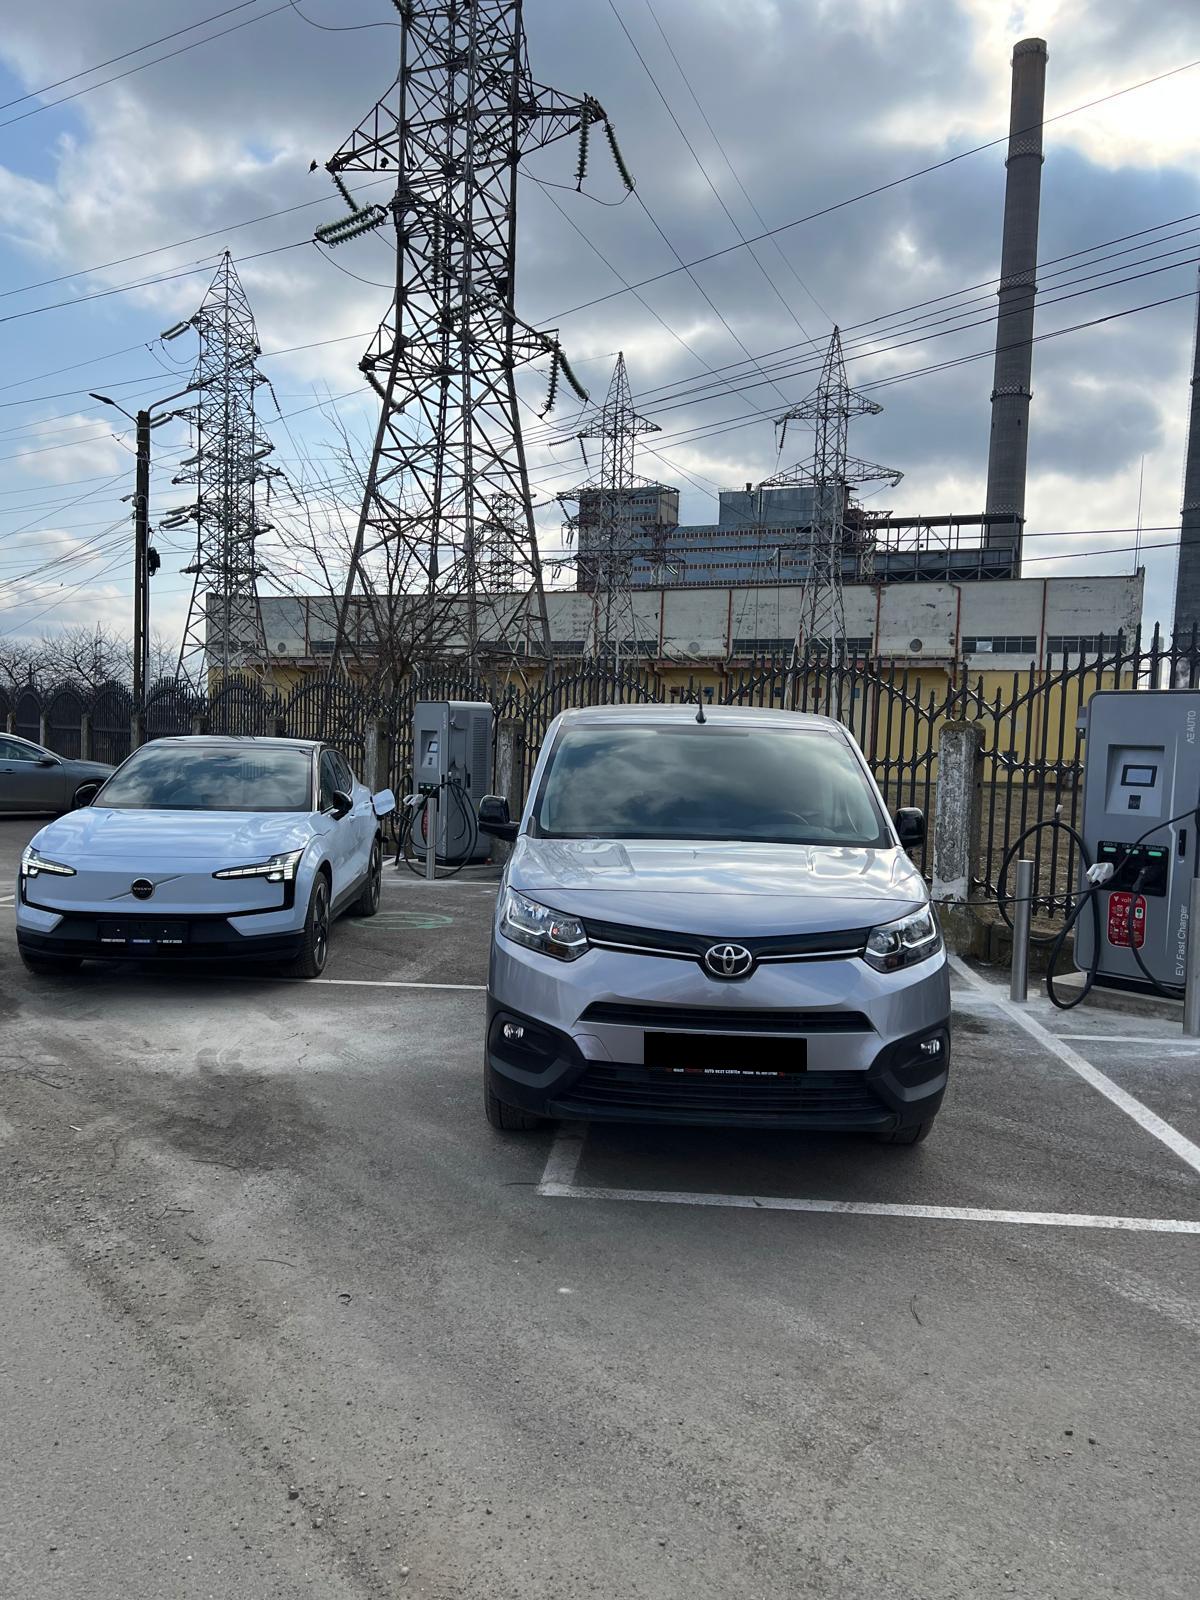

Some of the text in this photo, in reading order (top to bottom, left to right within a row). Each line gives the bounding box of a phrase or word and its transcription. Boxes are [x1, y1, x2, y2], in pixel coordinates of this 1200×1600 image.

[1175, 904, 1189, 977] EV Fast Charger
